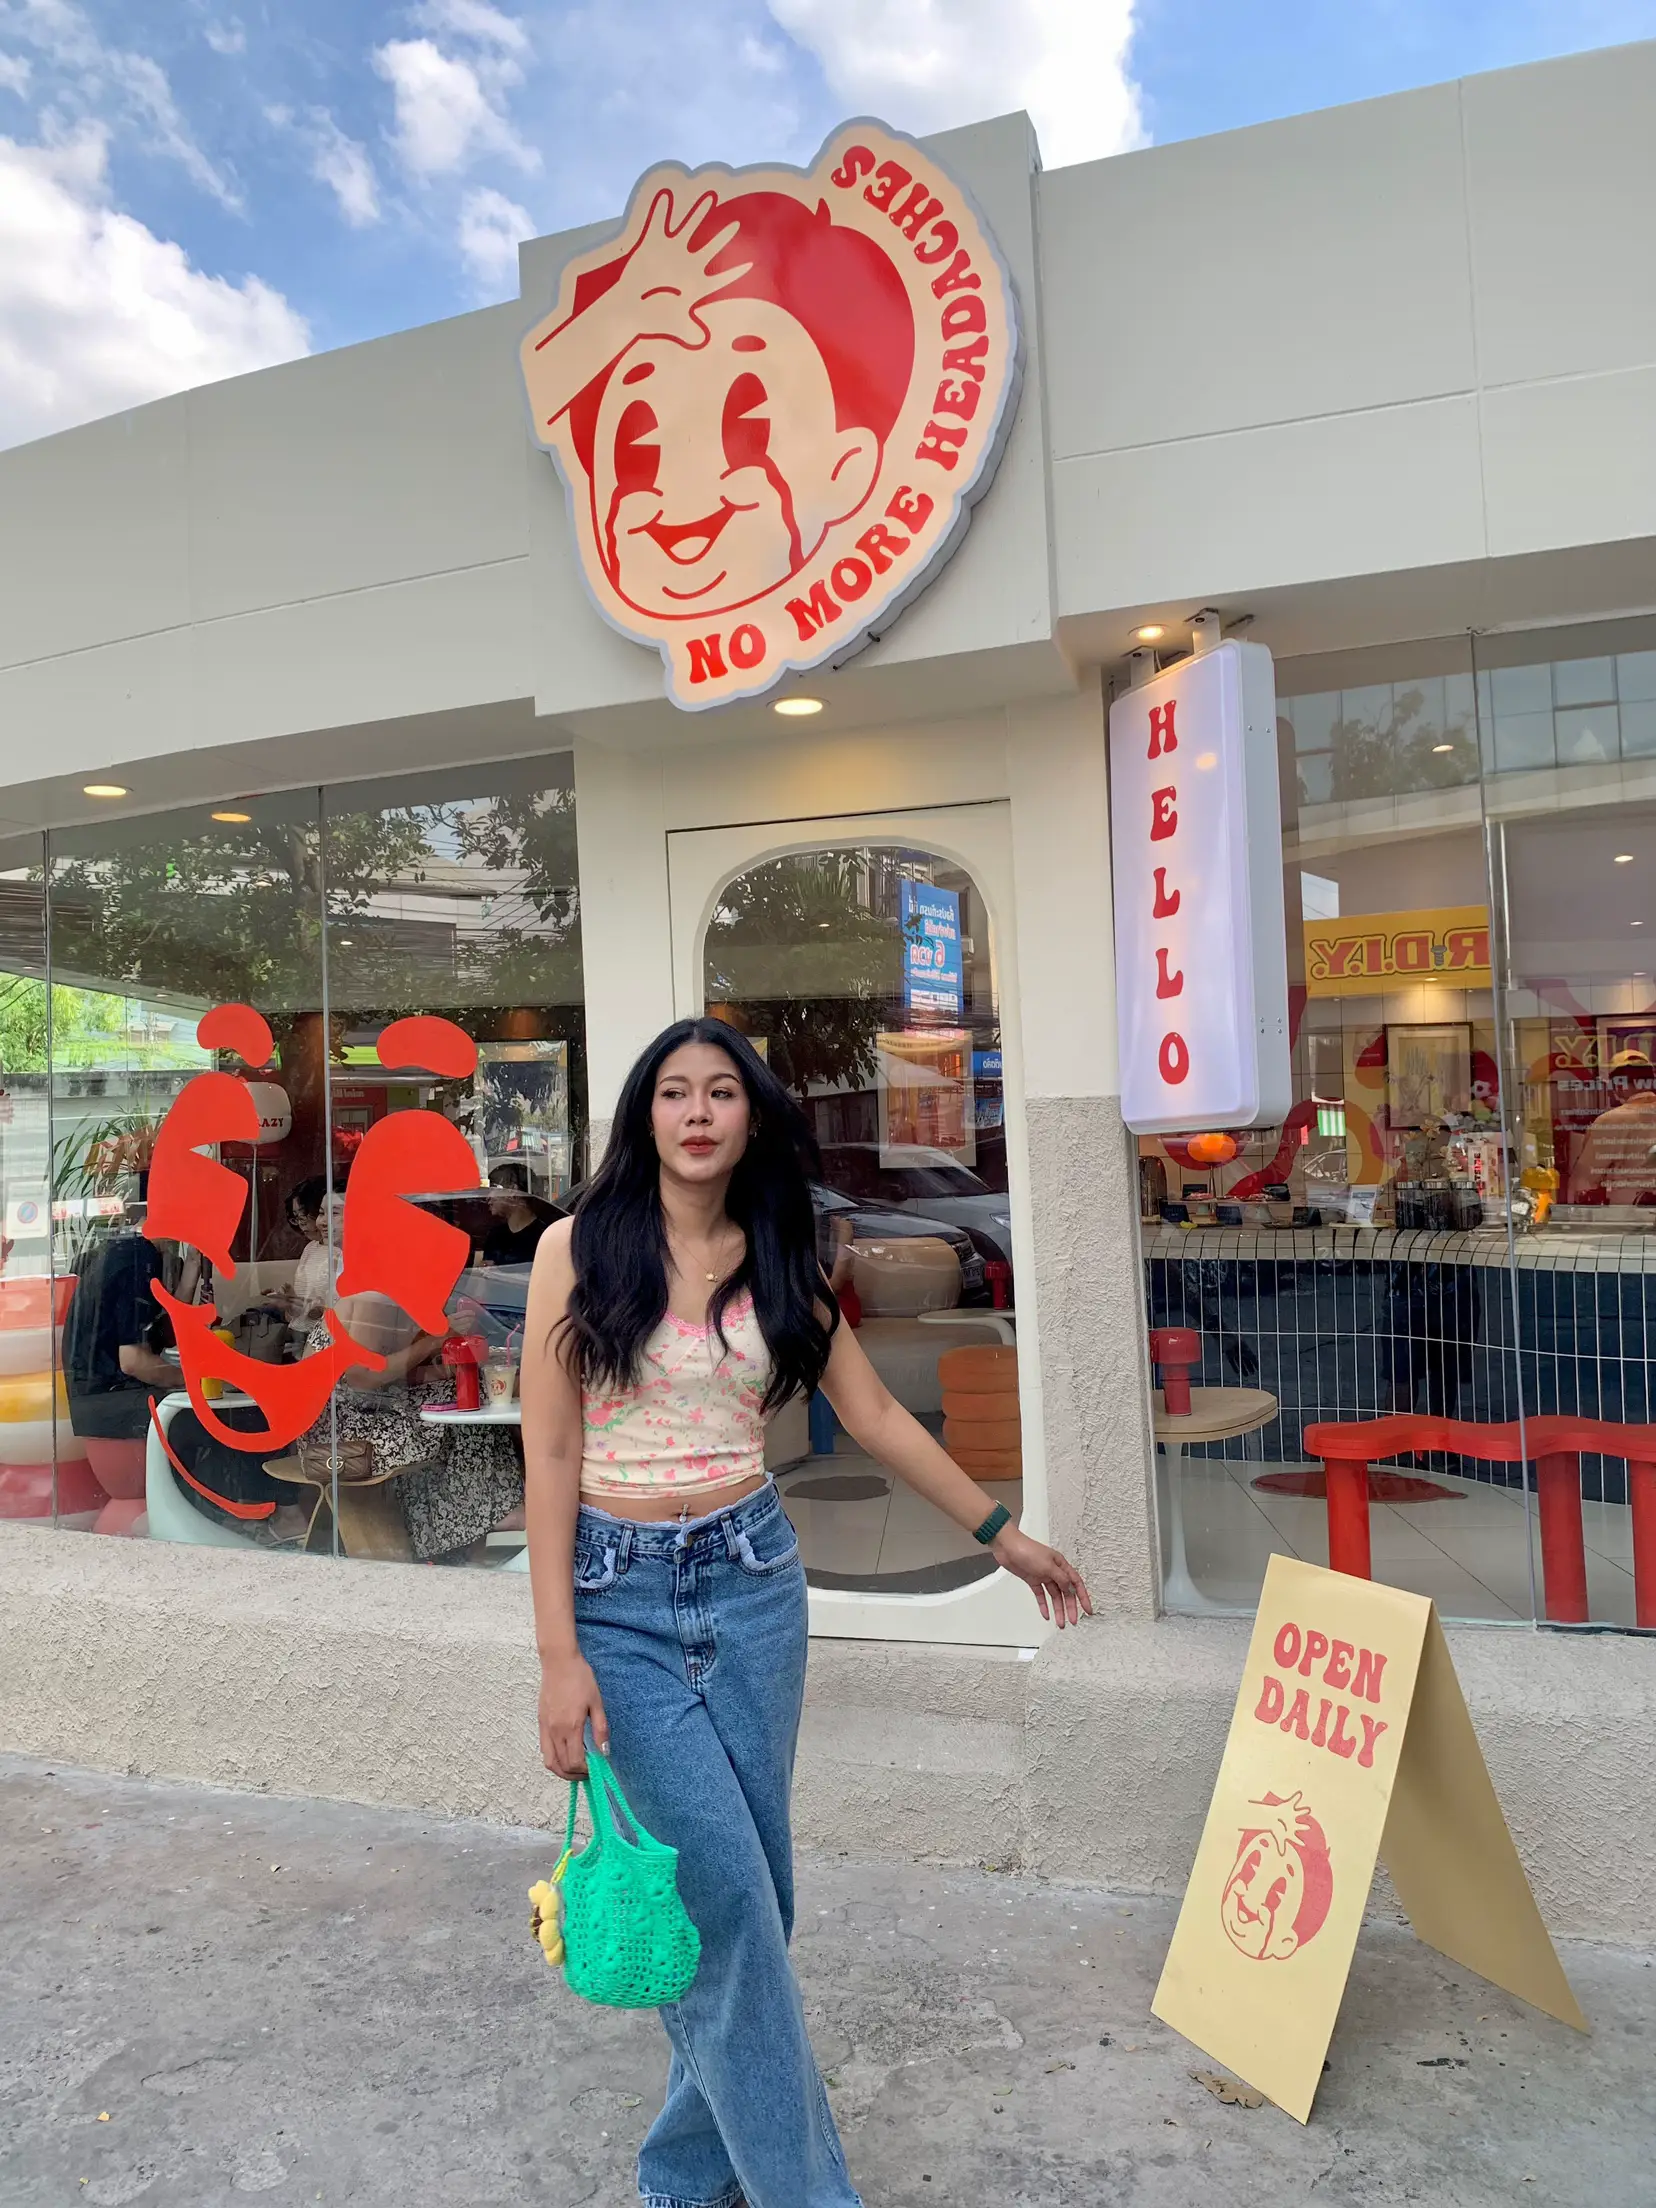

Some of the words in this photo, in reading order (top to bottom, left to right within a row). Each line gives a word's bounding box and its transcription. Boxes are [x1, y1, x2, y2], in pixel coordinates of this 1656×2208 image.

[831, 146, 990, 472] HEADACHES
[783, 484, 935, 642] MORE
[685, 623, 767, 685] NO
[1146, 698, 1190, 1086] HELLO
[258, 1117, 284, 1128] AZY
[1273, 1622, 1388, 1704] OPEN
[1255, 1676, 1388, 1768] DAILY
